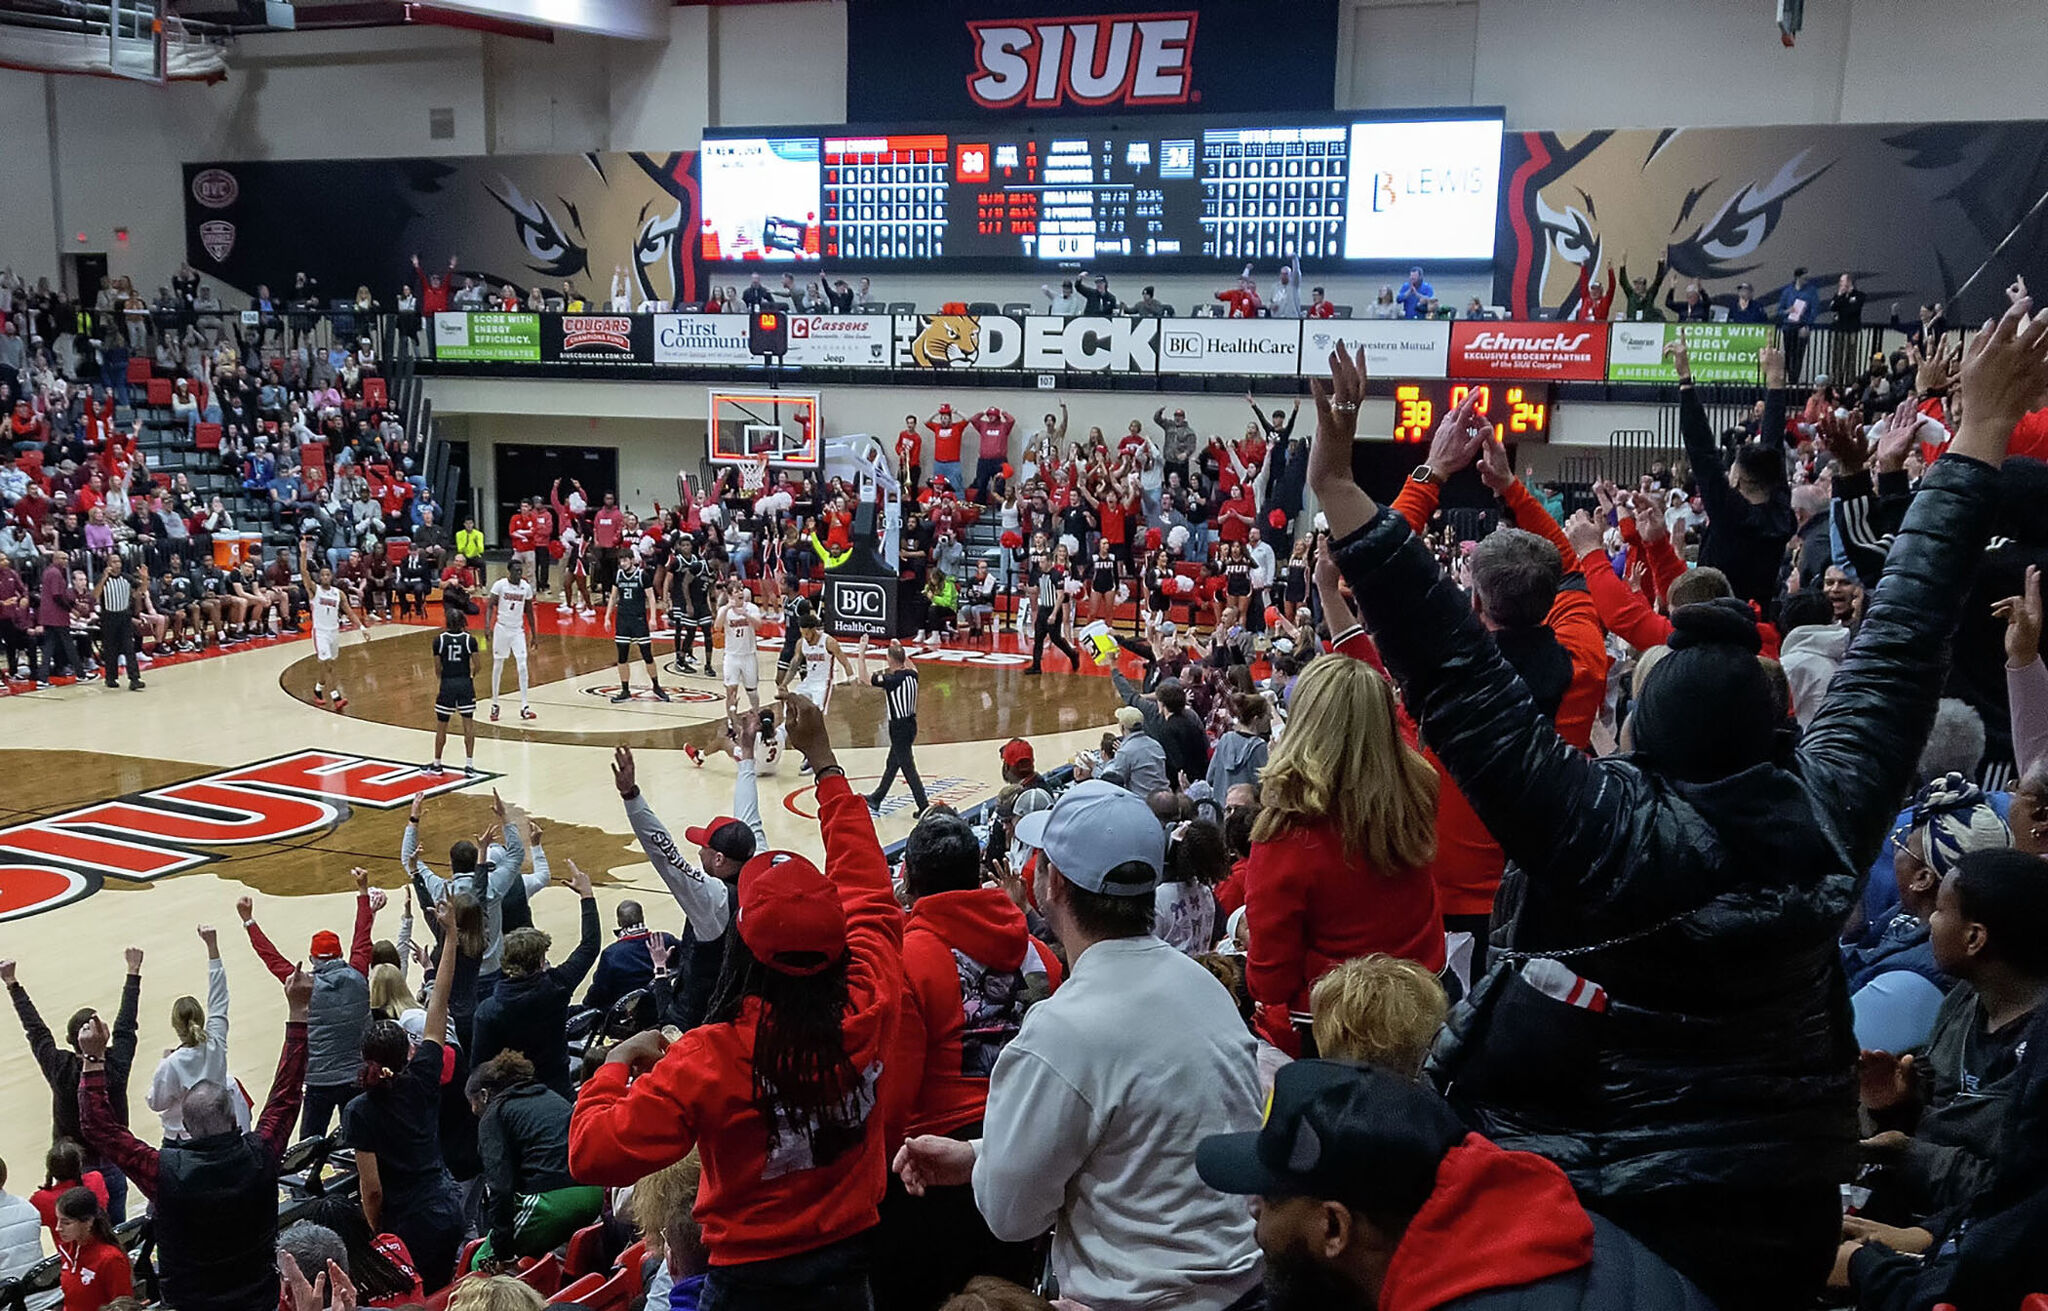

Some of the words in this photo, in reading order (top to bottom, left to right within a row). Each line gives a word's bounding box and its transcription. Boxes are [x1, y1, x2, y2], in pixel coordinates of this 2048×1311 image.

[967, 13, 1197, 106] SIUE
[1405, 167, 1483, 196] LEWIS
[473, 315, 505, 324] SCORE
[508, 315, 534, 324] WITH
[563, 317, 631, 333] COUGARS
[677, 318, 717, 336] First
[811, 317, 869, 331] Cassens
[473, 325, 510, 334] ENERGY
[1675, 326, 1722, 337] SCORE
[1728, 326, 1765, 337] WITH
[474, 335, 531, 344] EFFICIENCY.
[976, 316, 1158, 371] DECK
[1168, 336, 1199, 356] BJC
[1206, 338, 1296, 356] HealthCare
[1331, 340, 1398, 351] Nrthwestern
[1400, 340, 1435, 351] Mutual
[1464, 332, 1591, 351] Schnucks
[823, 353, 845, 364] Jeep
[1464, 352, 1509, 360] EXCLUSIVE
[1510, 353, 1551, 361] GROCERY
[1552, 353, 1592, 362] PARTNER
[1686, 351, 1758, 363] FICIENCY.
[1490, 360, 1499, 368] of
[1500, 360, 1512, 368] the
[1532, 361, 1562, 370] Cougars
[1039, 376, 1054, 388] 107
[1402, 400, 1432, 427] 38
[1511, 403, 1545, 431] 24
[623, 588, 633, 599] 21
[840, 589, 880, 615] BJC
[834, 620, 886, 634] HealthCare
[447, 645, 462, 661] 12
[766, 747, 777, 763] 3
